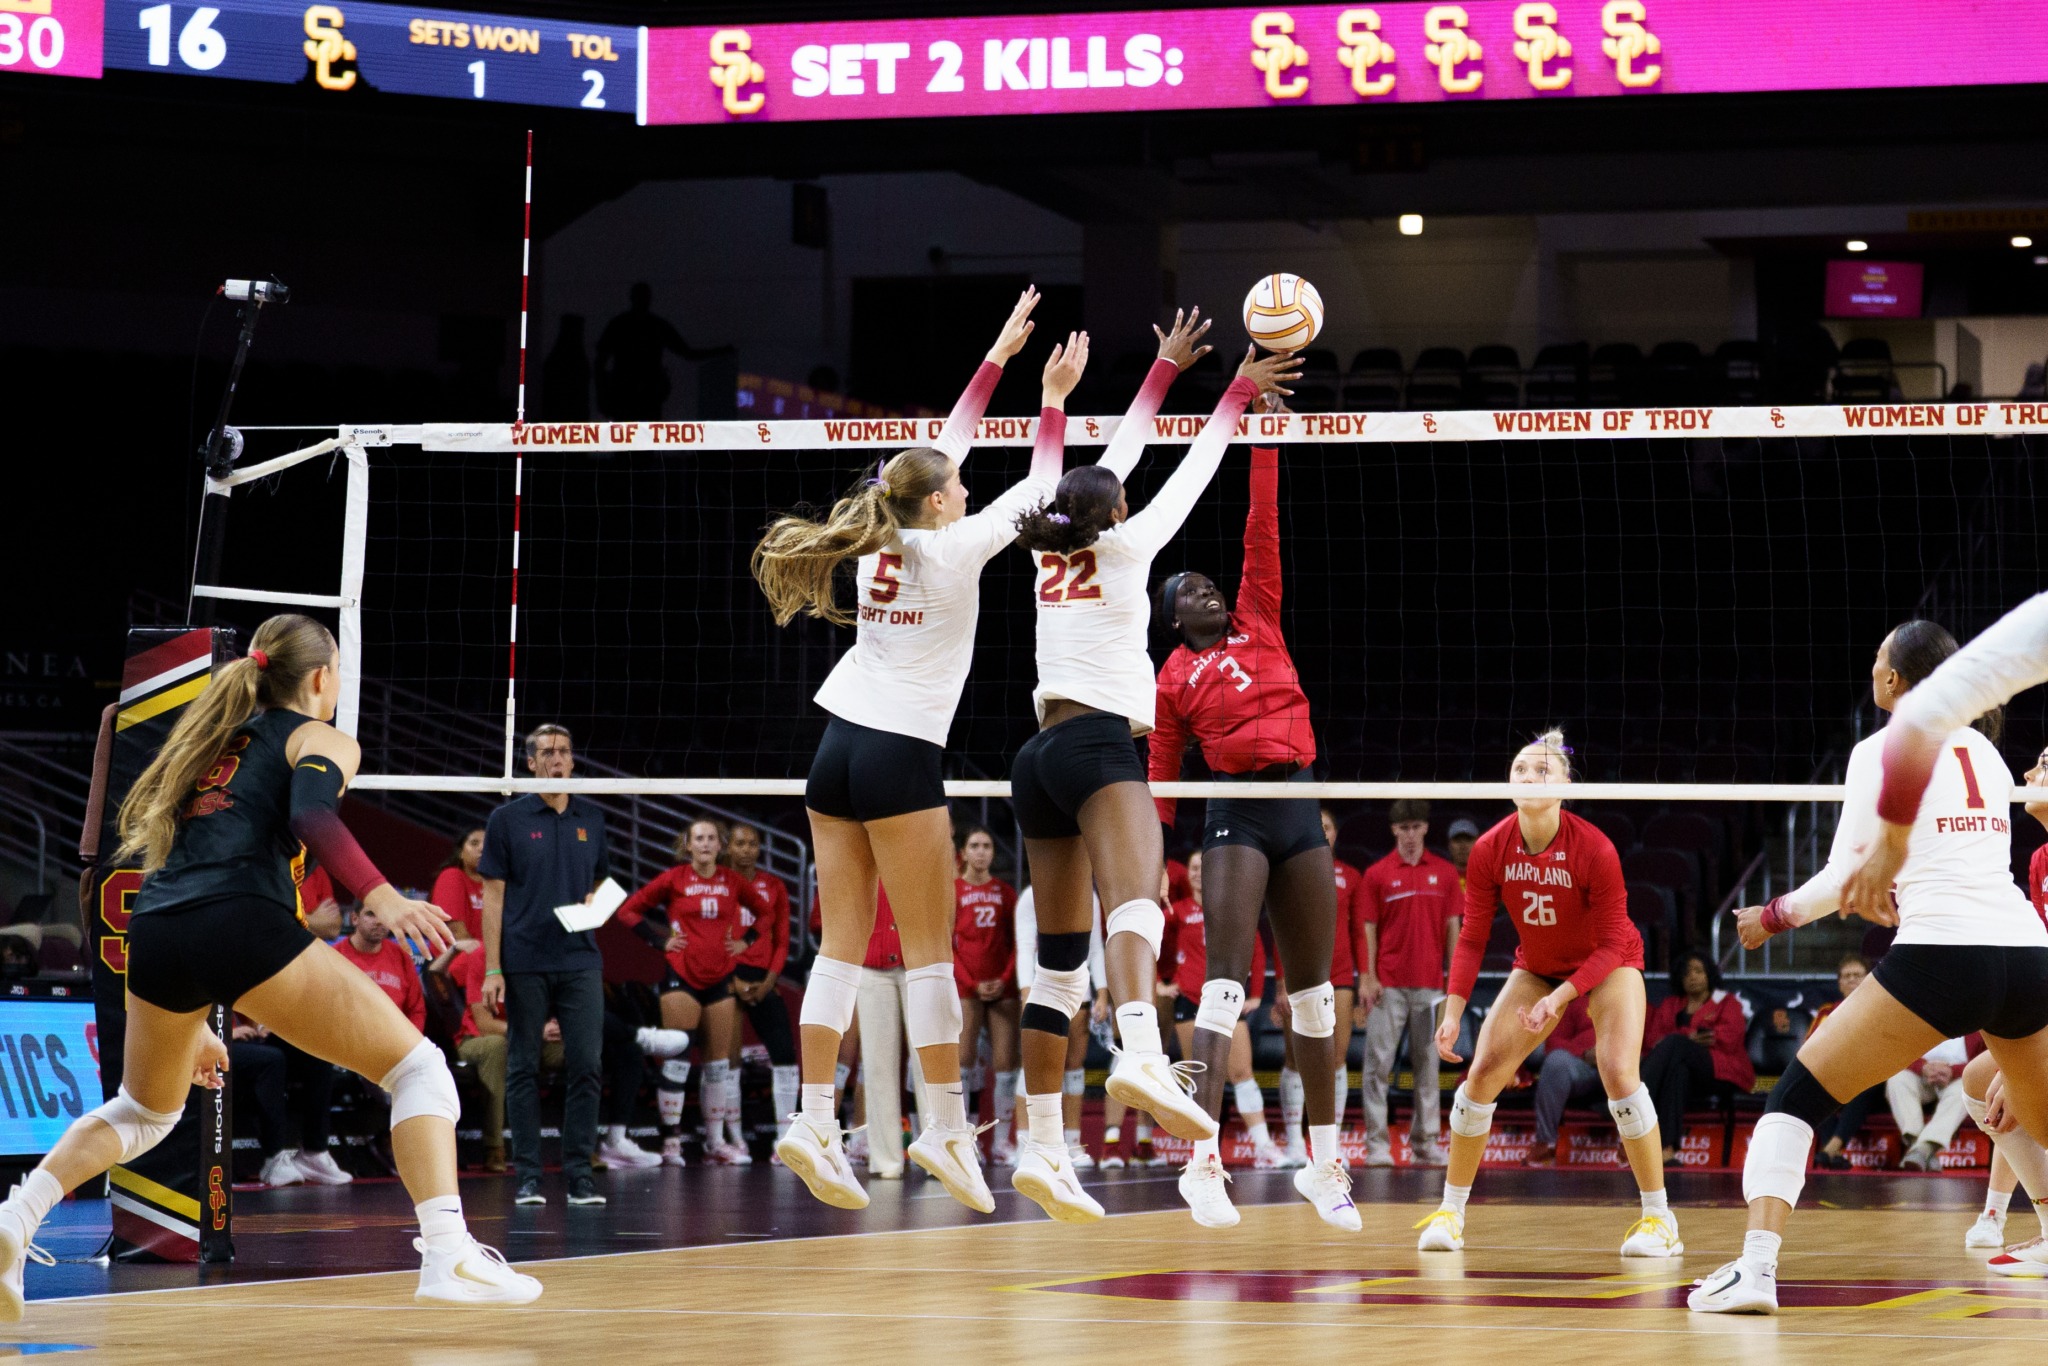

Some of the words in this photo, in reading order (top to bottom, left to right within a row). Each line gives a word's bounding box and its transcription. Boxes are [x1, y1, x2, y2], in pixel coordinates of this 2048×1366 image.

[0, 13, 65, 69] 30
[139, 4, 227, 70] 16
[409, 18, 470, 48] SETS
[472, 24, 540, 55] WON
[566, 33, 619, 61] TOL
[467, 60, 485, 98] 1
[791, 42, 910, 97] SET
[926, 40, 964, 92] 2
[983, 34, 1184, 92] KILLS:
[580, 69, 606, 109] 2
[1154, 416, 1249, 437] WOMN
[1260, 415, 1290, 436] OF
[1301, 414, 1367, 435] TROY
[1493, 411, 1592, 432] WOMEN
[1603, 411, 1633, 431] OF
[1645, 409, 1713, 430] TROY
[1842, 406, 1945, 427] WOMEN
[1956, 405, 1988, 426] OF
[511, 424, 600, 445] WOMEN
[610, 424, 638, 443] OF
[824, 420, 917, 441] WOMEN
[928, 420, 946, 440] O
[869, 552, 903, 604] 5
[1039, 550, 1101, 602] 22
[890, 610, 924, 625] ON!
[1217, 656, 1253, 692] 3
[1953, 747, 1985, 809] 1
[1936, 816, 1988, 833] FIGHT
[1504, 862, 1573, 889] MARYLAND
[684, 883, 729, 897] MARYLAND
[701, 897, 718, 919] 10
[974, 906, 997, 928] 22
[1522, 891, 1557, 926] 26
